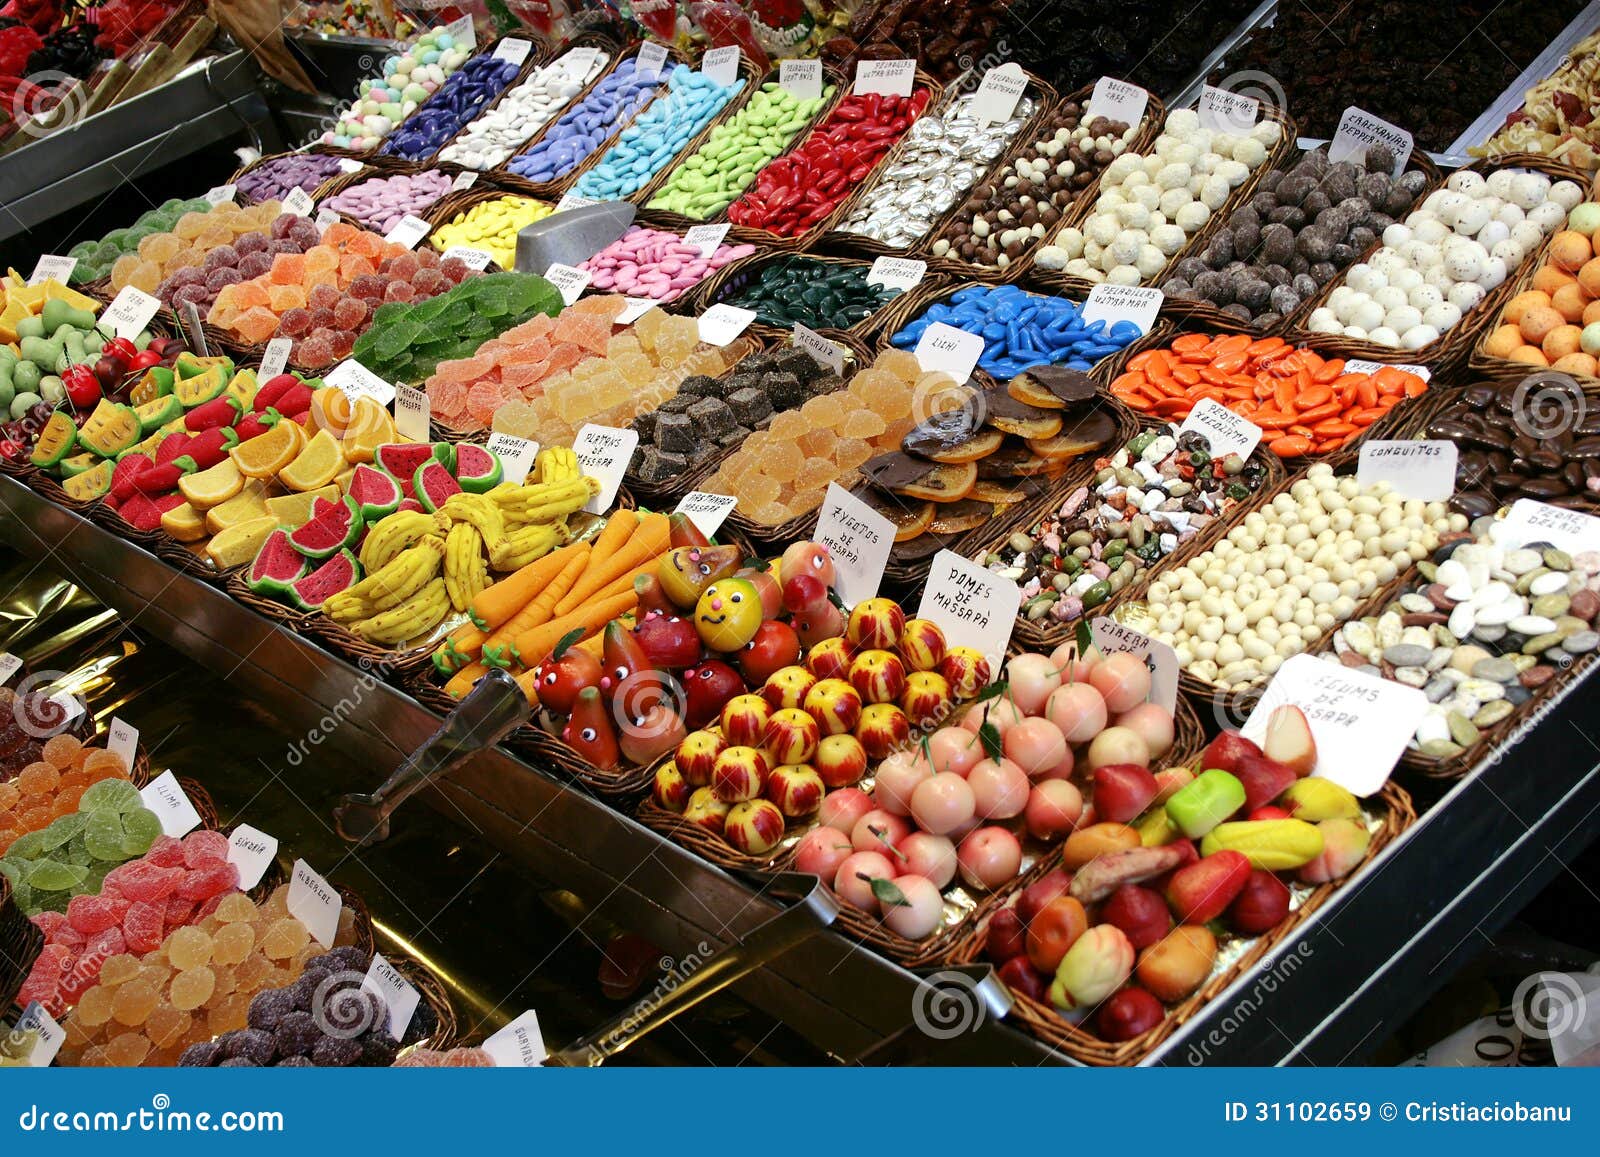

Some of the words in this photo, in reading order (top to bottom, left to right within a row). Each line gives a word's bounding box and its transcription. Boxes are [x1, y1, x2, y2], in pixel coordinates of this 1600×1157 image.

[1127, 298, 1148, 308] MAR
[798, 332, 834, 357] REGALIZ
[1369, 444, 1441, 457] CONGUITOS
[831, 505, 880, 545] ZYGOTOS
[839, 532, 854, 547] DE
[948, 567, 993, 600] POMES
[955, 590, 971, 604] DE
[1100, 623, 1150, 649] CIRERA
[157, 785, 181, 809] LLIMA
[376, 963, 405, 991] CIRERA
